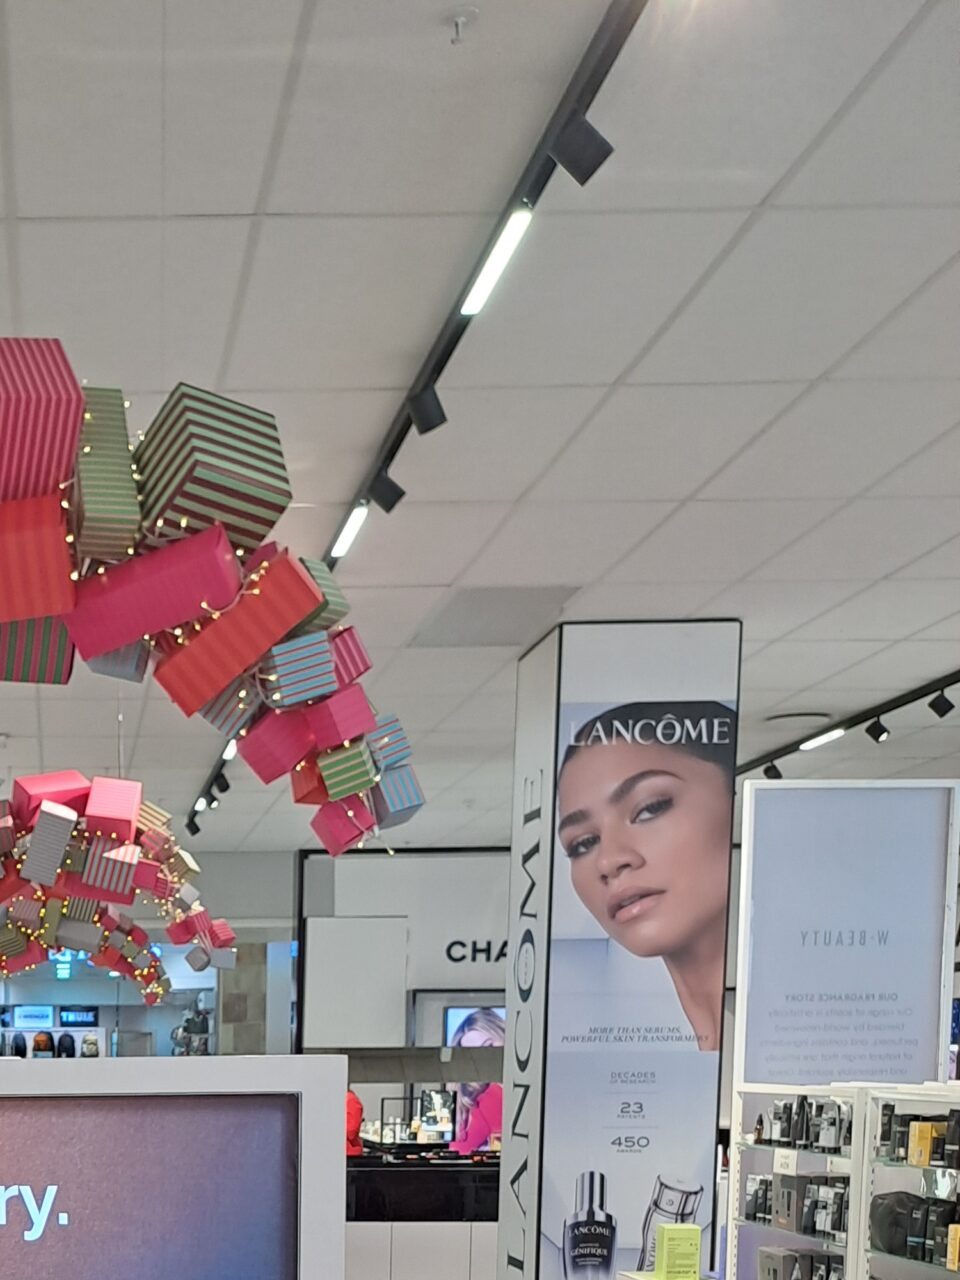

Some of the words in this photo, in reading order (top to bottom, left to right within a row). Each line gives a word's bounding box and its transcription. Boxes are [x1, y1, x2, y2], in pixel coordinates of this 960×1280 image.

[569, 714, 732, 746] LANCÔME
[610, 1071, 657, 1079] DECADES
[620, 1101, 644, 1114] 23
[610, 1136, 650, 1149] 450
